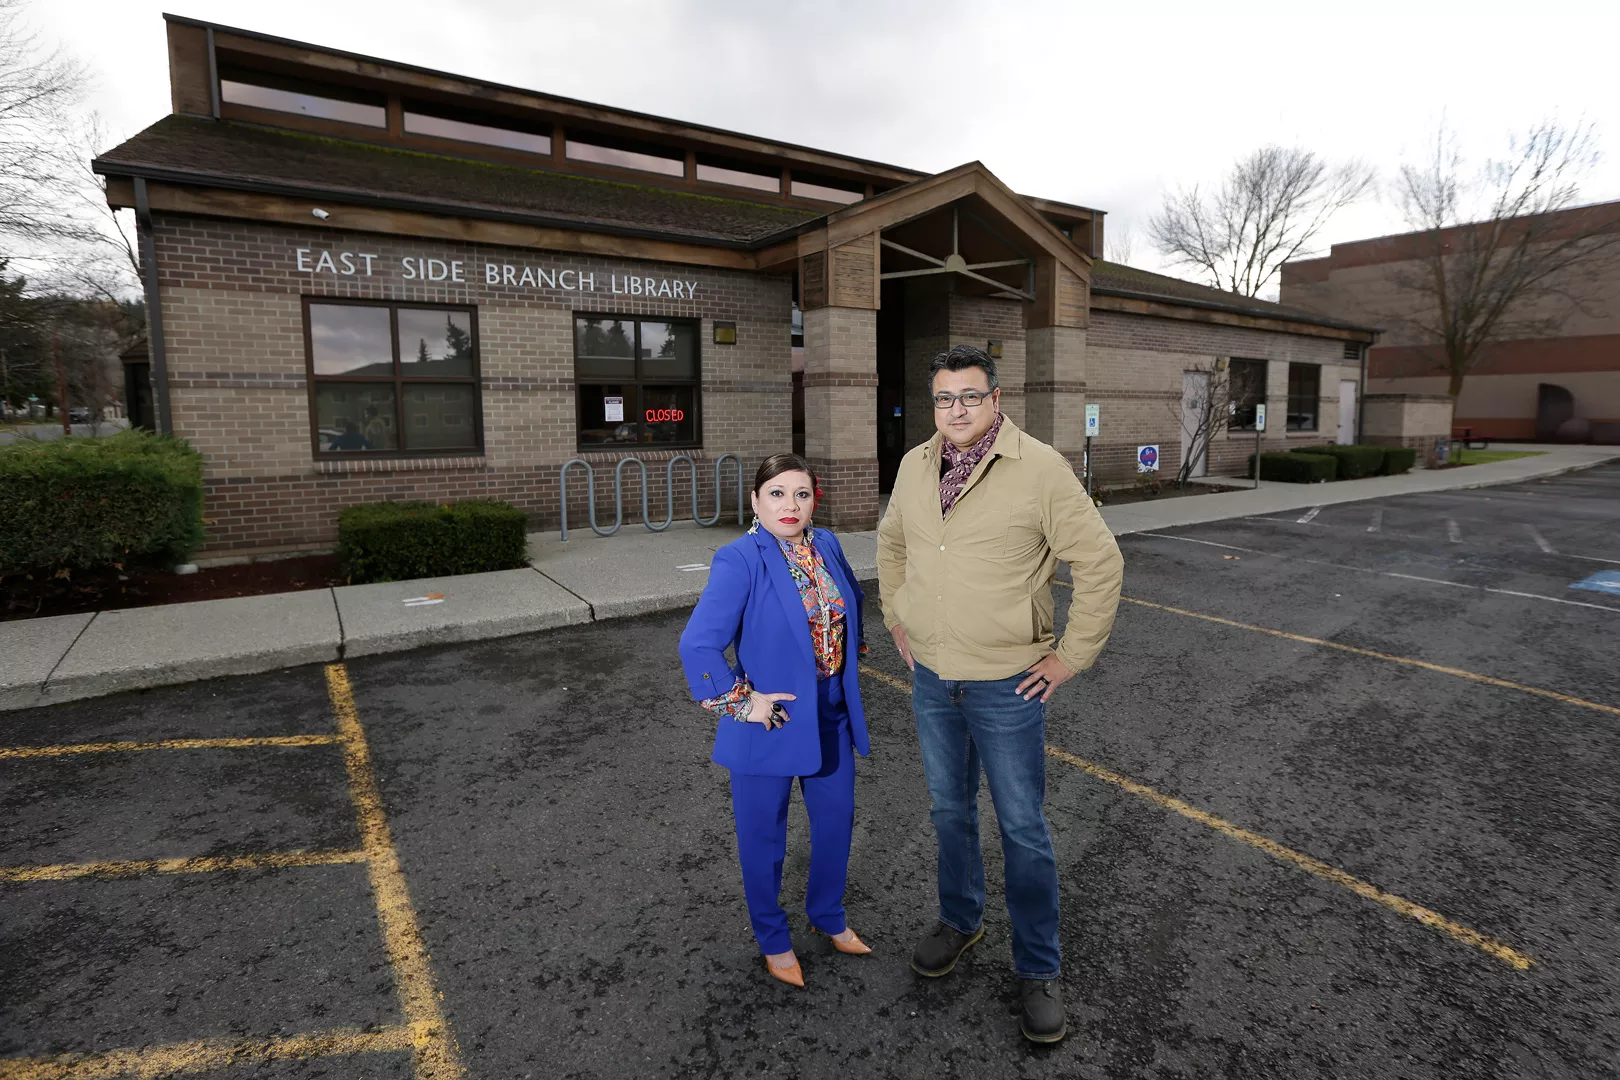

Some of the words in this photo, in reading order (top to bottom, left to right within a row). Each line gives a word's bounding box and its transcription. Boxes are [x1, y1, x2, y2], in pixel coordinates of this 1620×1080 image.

[296, 248, 378, 276] EAST
[402, 257, 465, 282] SIDE
[485, 263, 594, 292] BRANCH
[611, 274, 698, 299] LIBRARY
[645, 409, 684, 422] CLOSED
